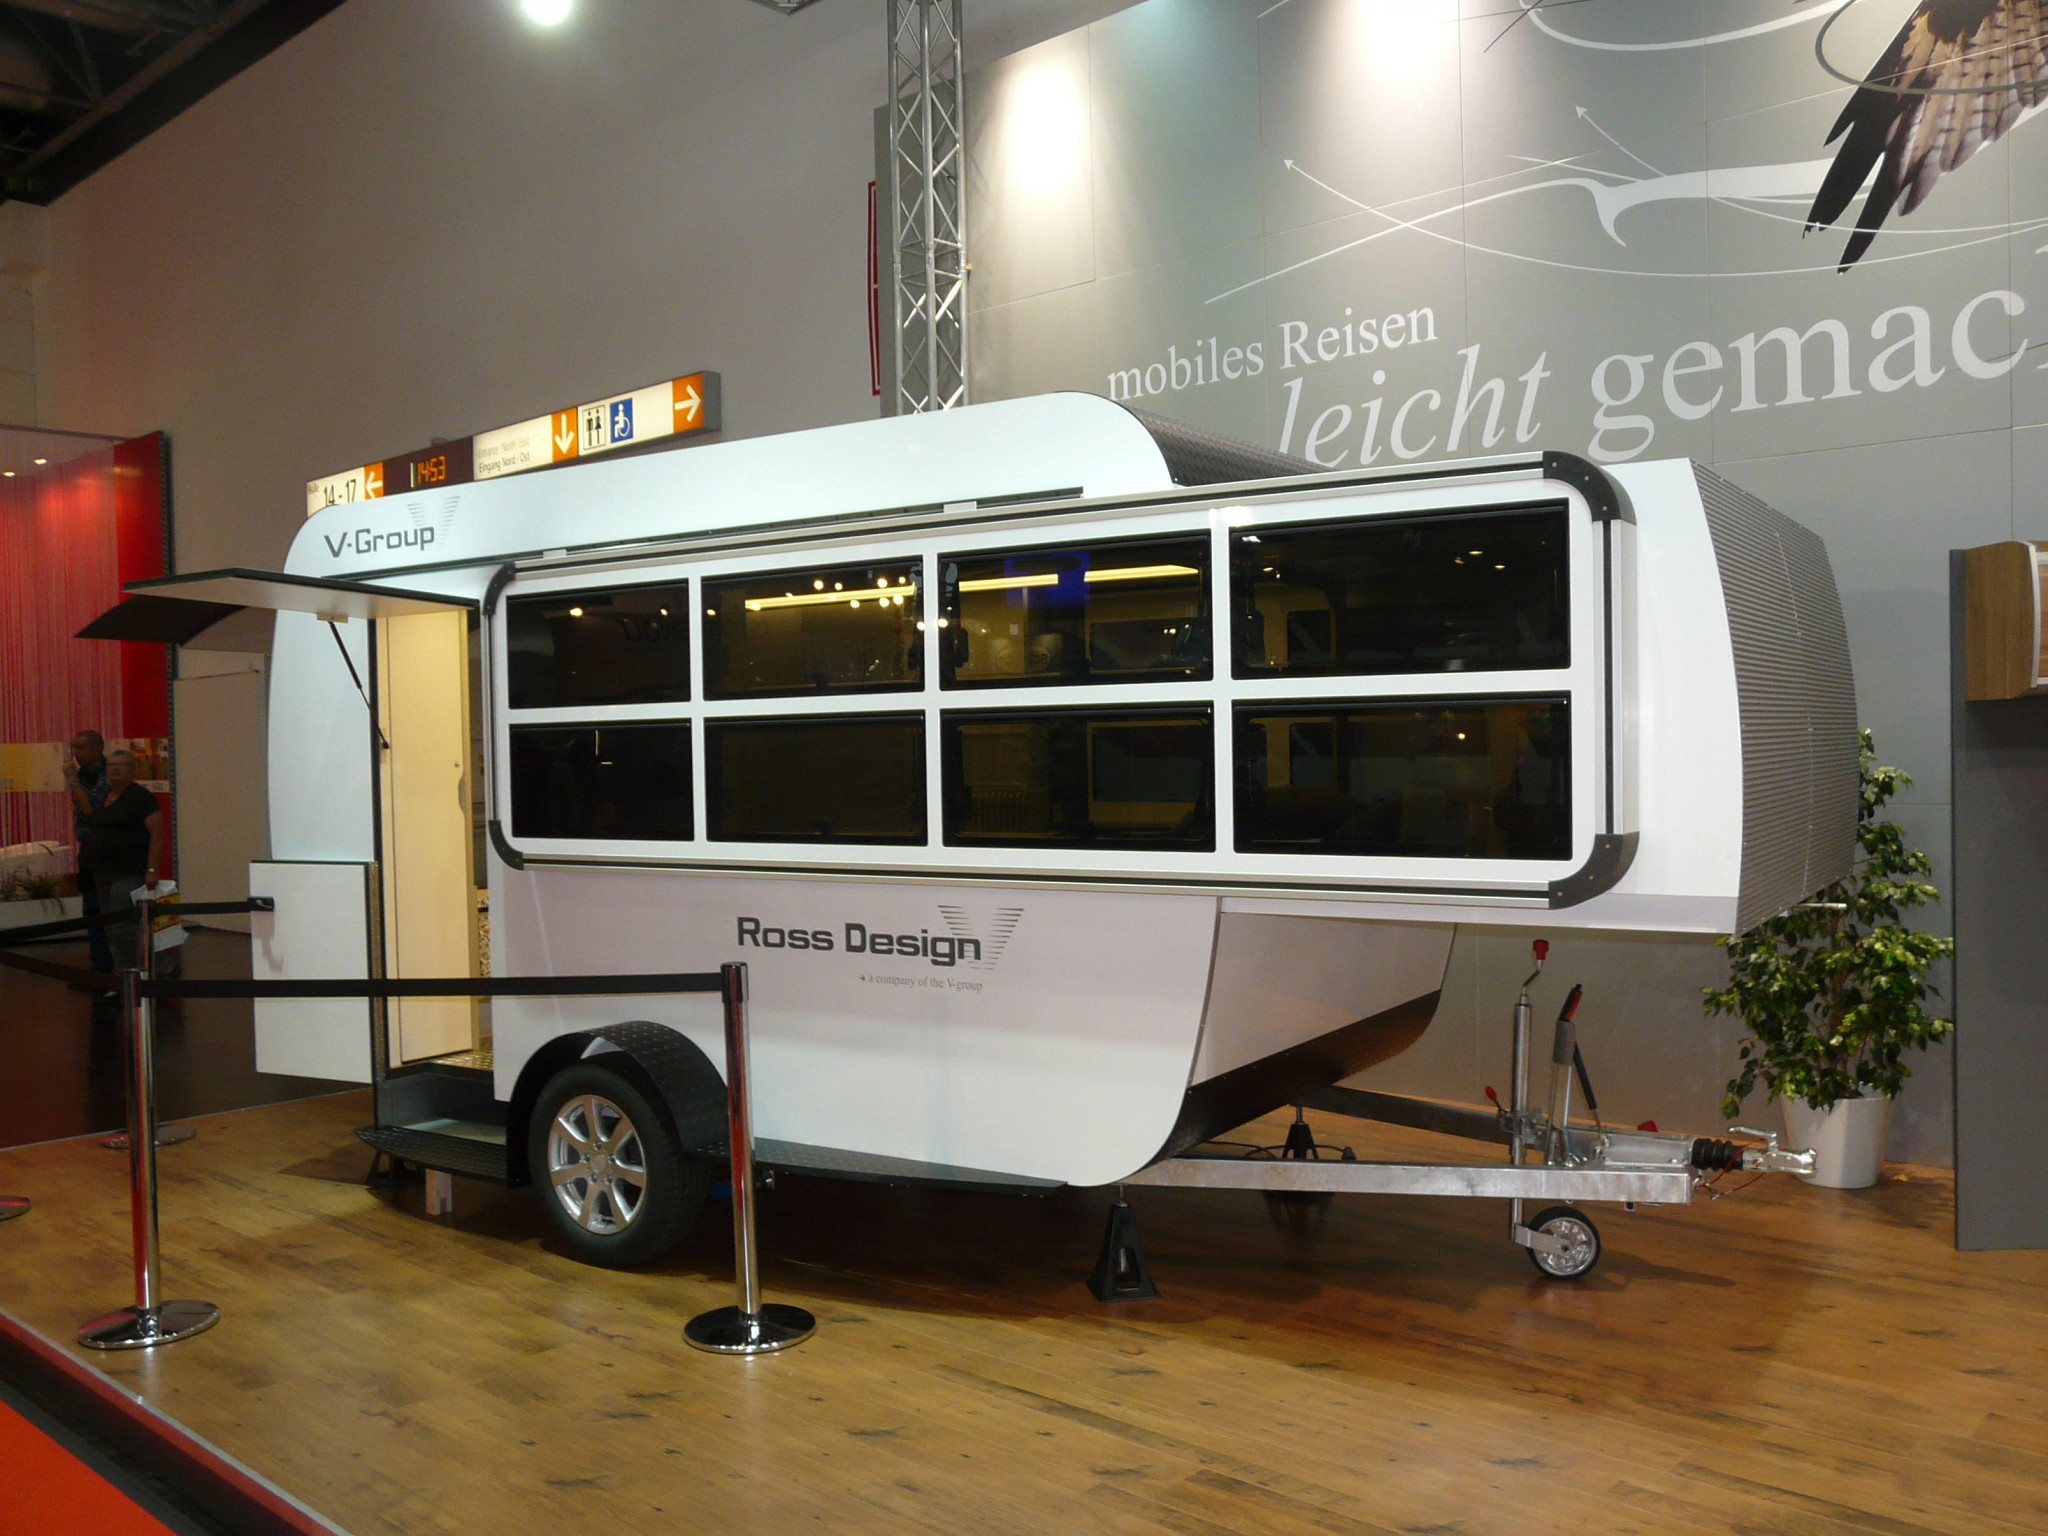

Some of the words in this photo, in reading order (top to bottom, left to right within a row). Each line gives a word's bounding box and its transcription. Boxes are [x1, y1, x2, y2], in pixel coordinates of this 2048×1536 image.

[1107, 336, 1264, 400] mobiles
[1278, 305, 1439, 369] Reisen
[1279, 344, 1551, 468] leicht
[1587, 246, 2048, 462] gemac
[479, 460, 501, 474] Eingang
[502, 453, 516, 467] Nord
[519, 451, 530, 463] Ost
[323, 526, 435, 559] V-Group
[737, 916, 834, 951] Ross
[845, 922, 981, 967] Design
[868, 975, 874, 983] a
[875, 975, 915, 988] company
[918, 976, 929, 987] of
[930, 977, 944, 988] the
[946, 977, 983, 993] V-group
